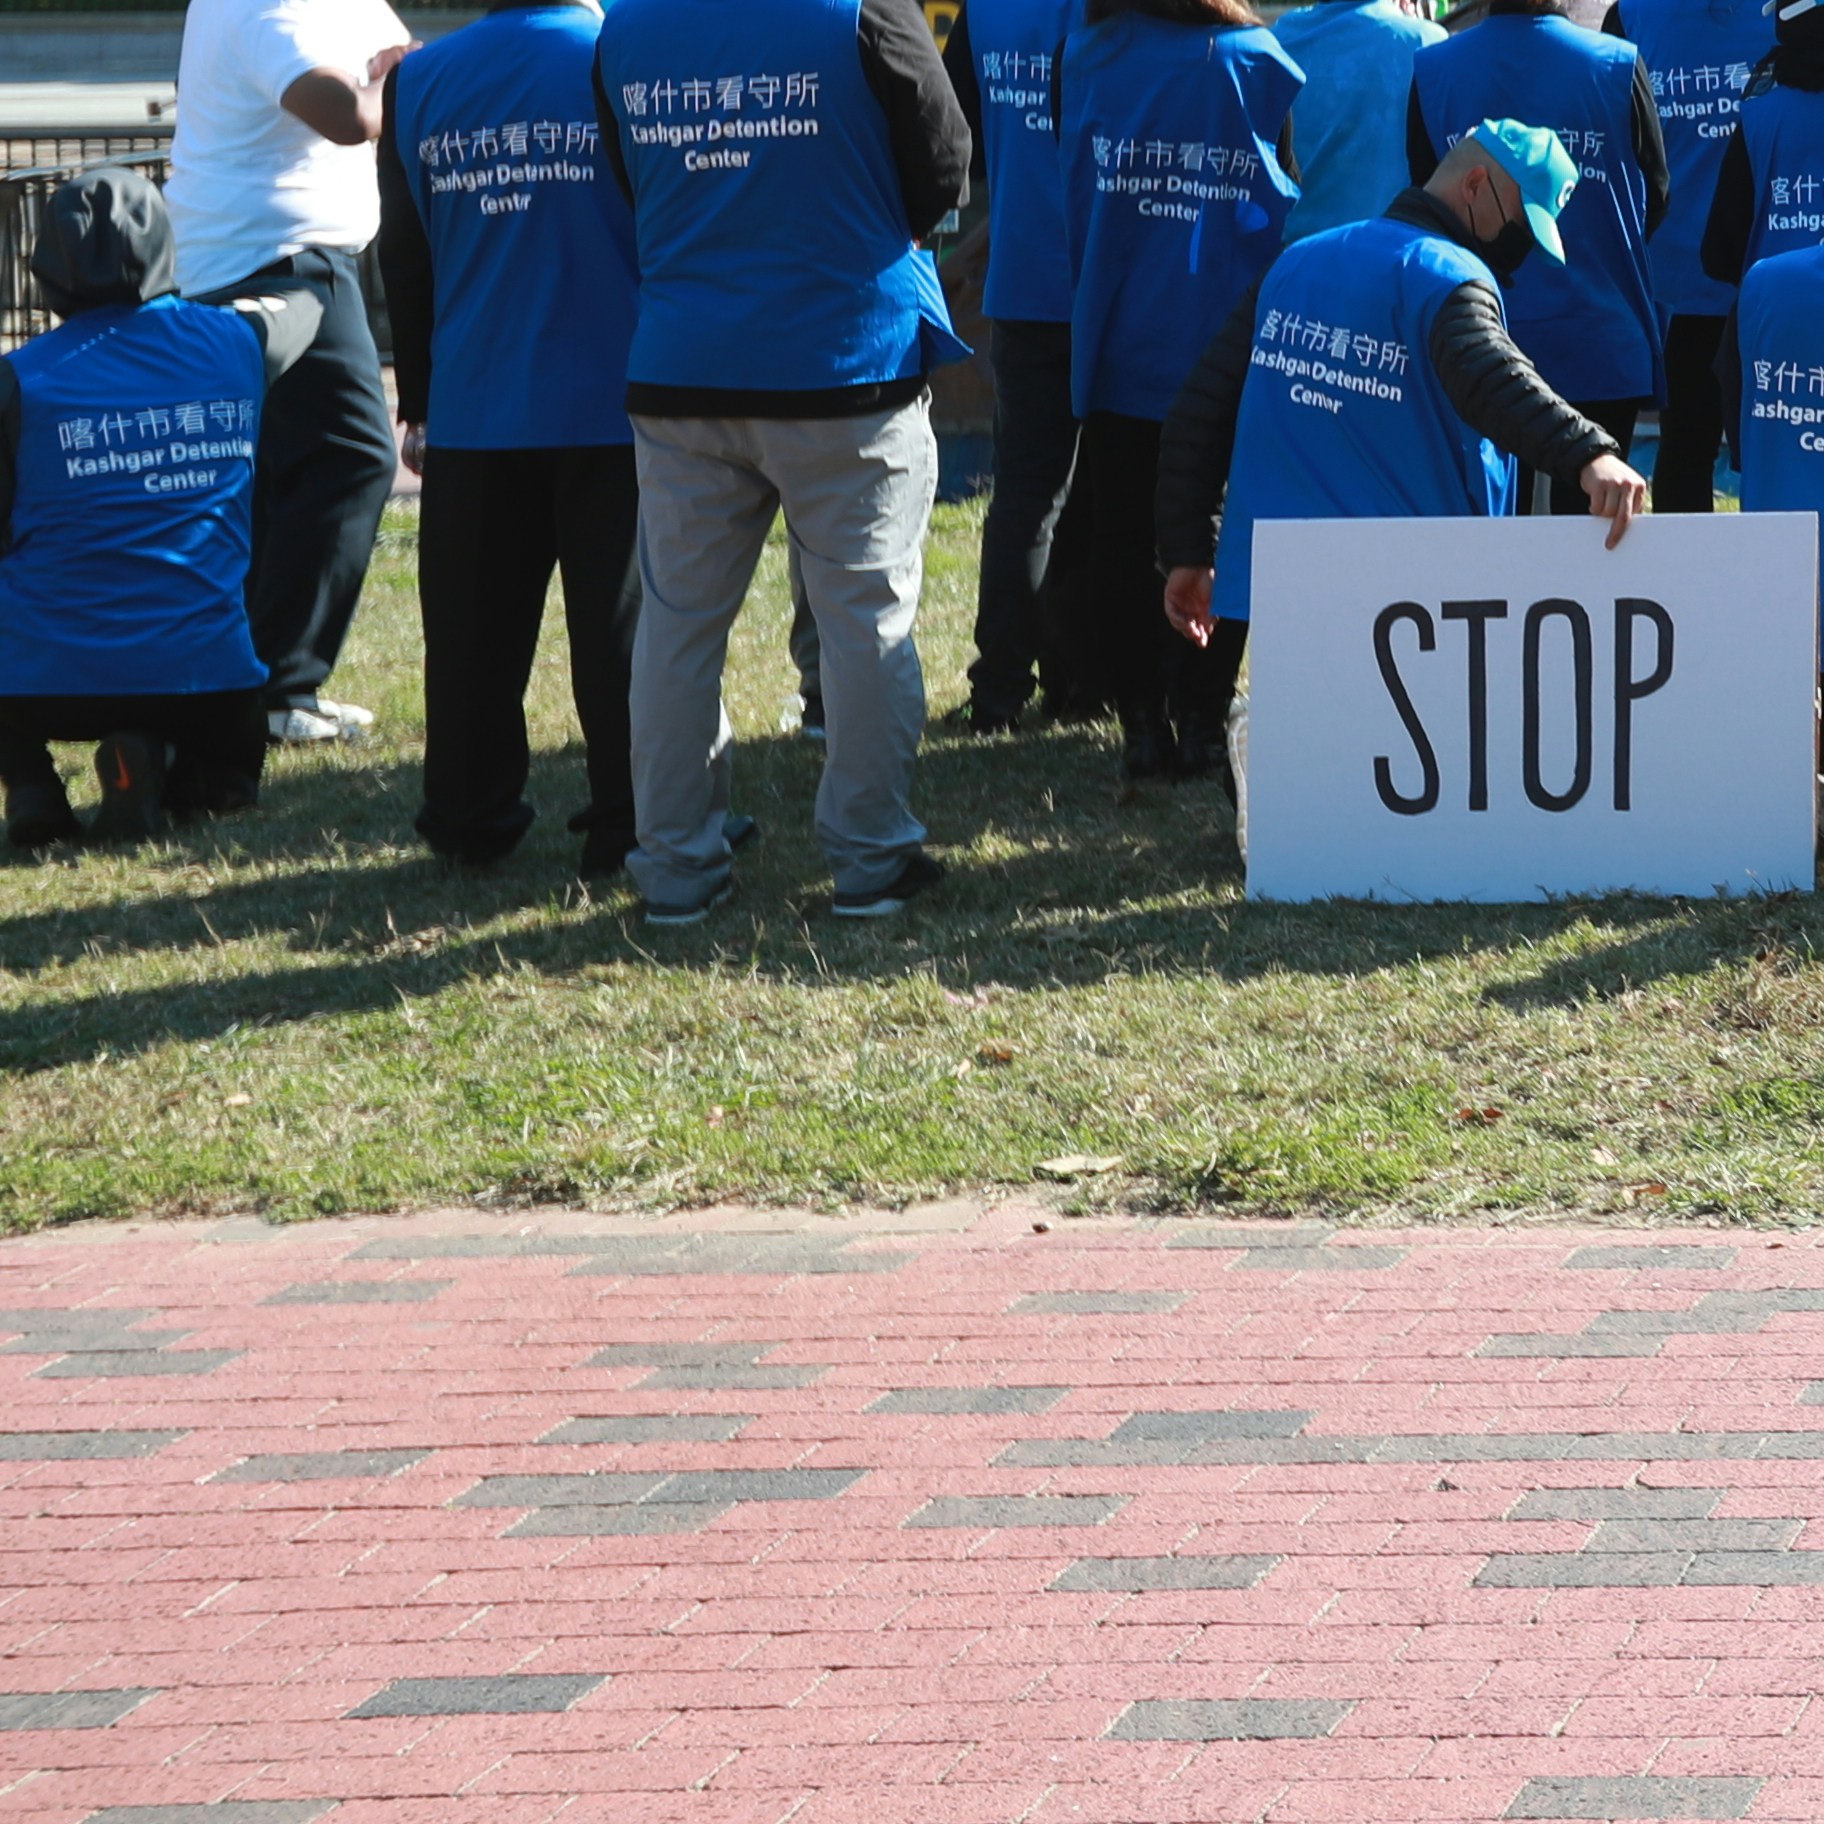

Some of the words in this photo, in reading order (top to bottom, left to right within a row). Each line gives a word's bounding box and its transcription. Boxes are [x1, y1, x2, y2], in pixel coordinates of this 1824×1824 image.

[623, 71, 819, 117] 喀什市看守所
[707, 115, 819, 142] Detention
[1697, 121, 1736, 140] Cent
[496, 161, 595, 186] Detention
[684, 149, 751, 173] Center
[1096, 173, 1162, 197] ashgar
[1167, 175, 1251, 203] Detention
[1138, 197, 1200, 223] Center
[1311, 360, 1402, 403] Detention
[66, 447, 165, 479] Kashgar
[144, 468, 218, 494] Center
[1372, 597, 1675, 816] STOP
